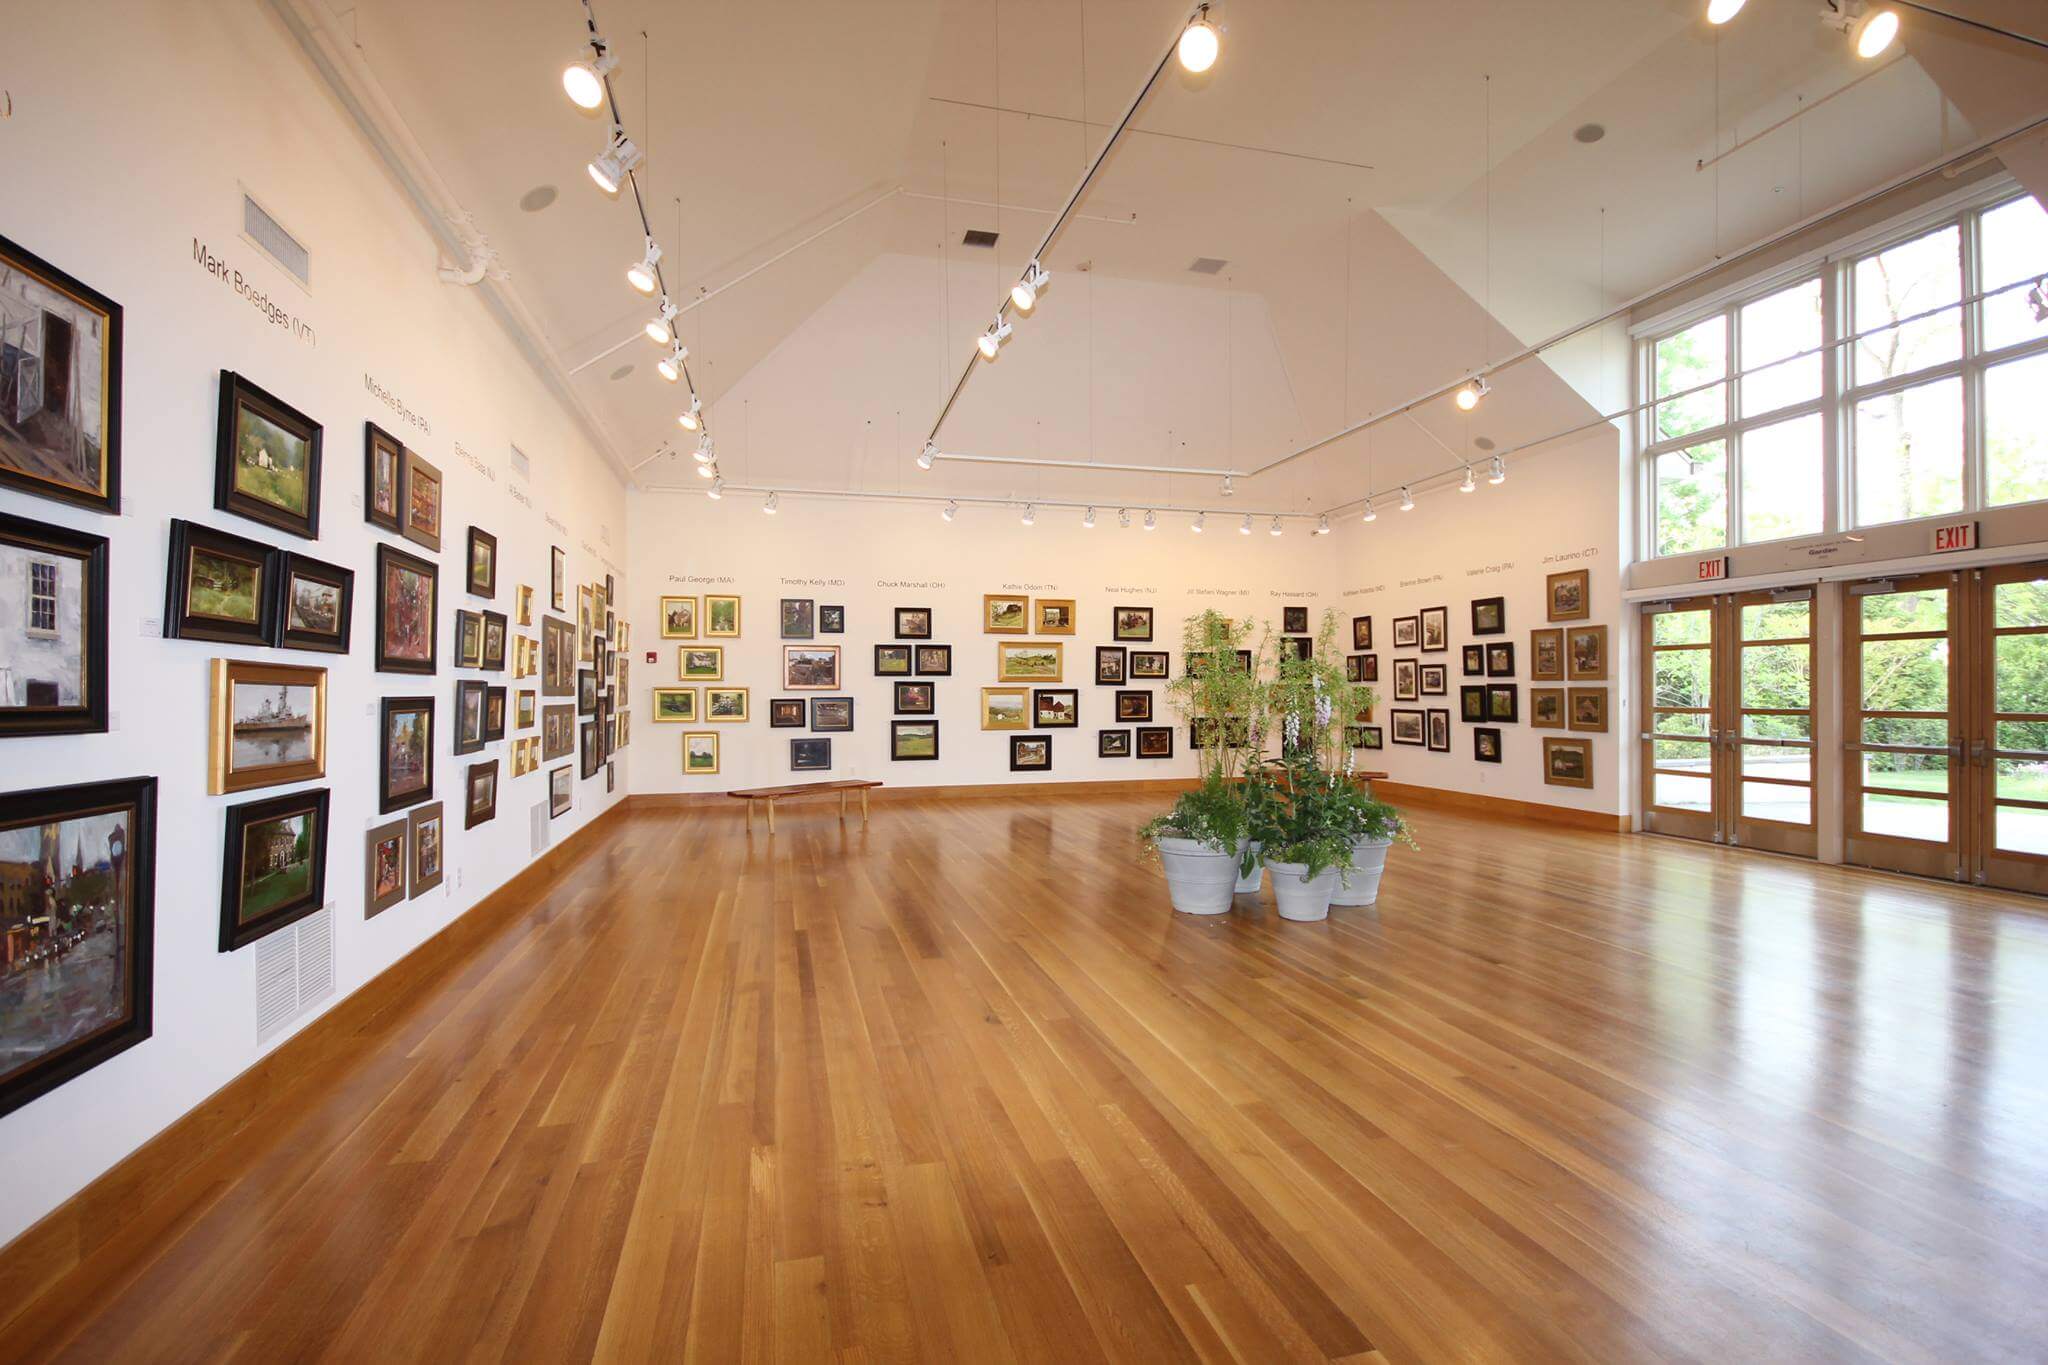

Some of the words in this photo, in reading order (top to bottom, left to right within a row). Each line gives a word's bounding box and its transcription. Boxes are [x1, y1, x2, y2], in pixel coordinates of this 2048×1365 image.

[193, 238, 230, 284] Mark
[234, 270, 289, 329] Boedges
[293, 317, 316, 347] (VT)
[1936, 525, 1969, 550] EXIT
[1542, 556, 1554, 564] Jim
[1555, 551, 1581, 562] Laurino
[1582, 547, 1599, 558] (CT)
[1699, 559, 1721, 579] EXIT
[669, 575, 686, 583] Paul
[687, 575, 716, 585] George
[717, 576, 735, 584] (MA)
[780, 577, 808, 586] Timothy
[809, 578, 826, 587] Kelly
[827, 579, 846, 587] (MD)
[877, 580, 899, 588] Chuck
[900, 581, 928, 589] Marshall
[929, 582, 946, 590] (OH)
[1003, 583, 1023, 591] Kathie
[1120, 586, 1144, 595] Hughes
